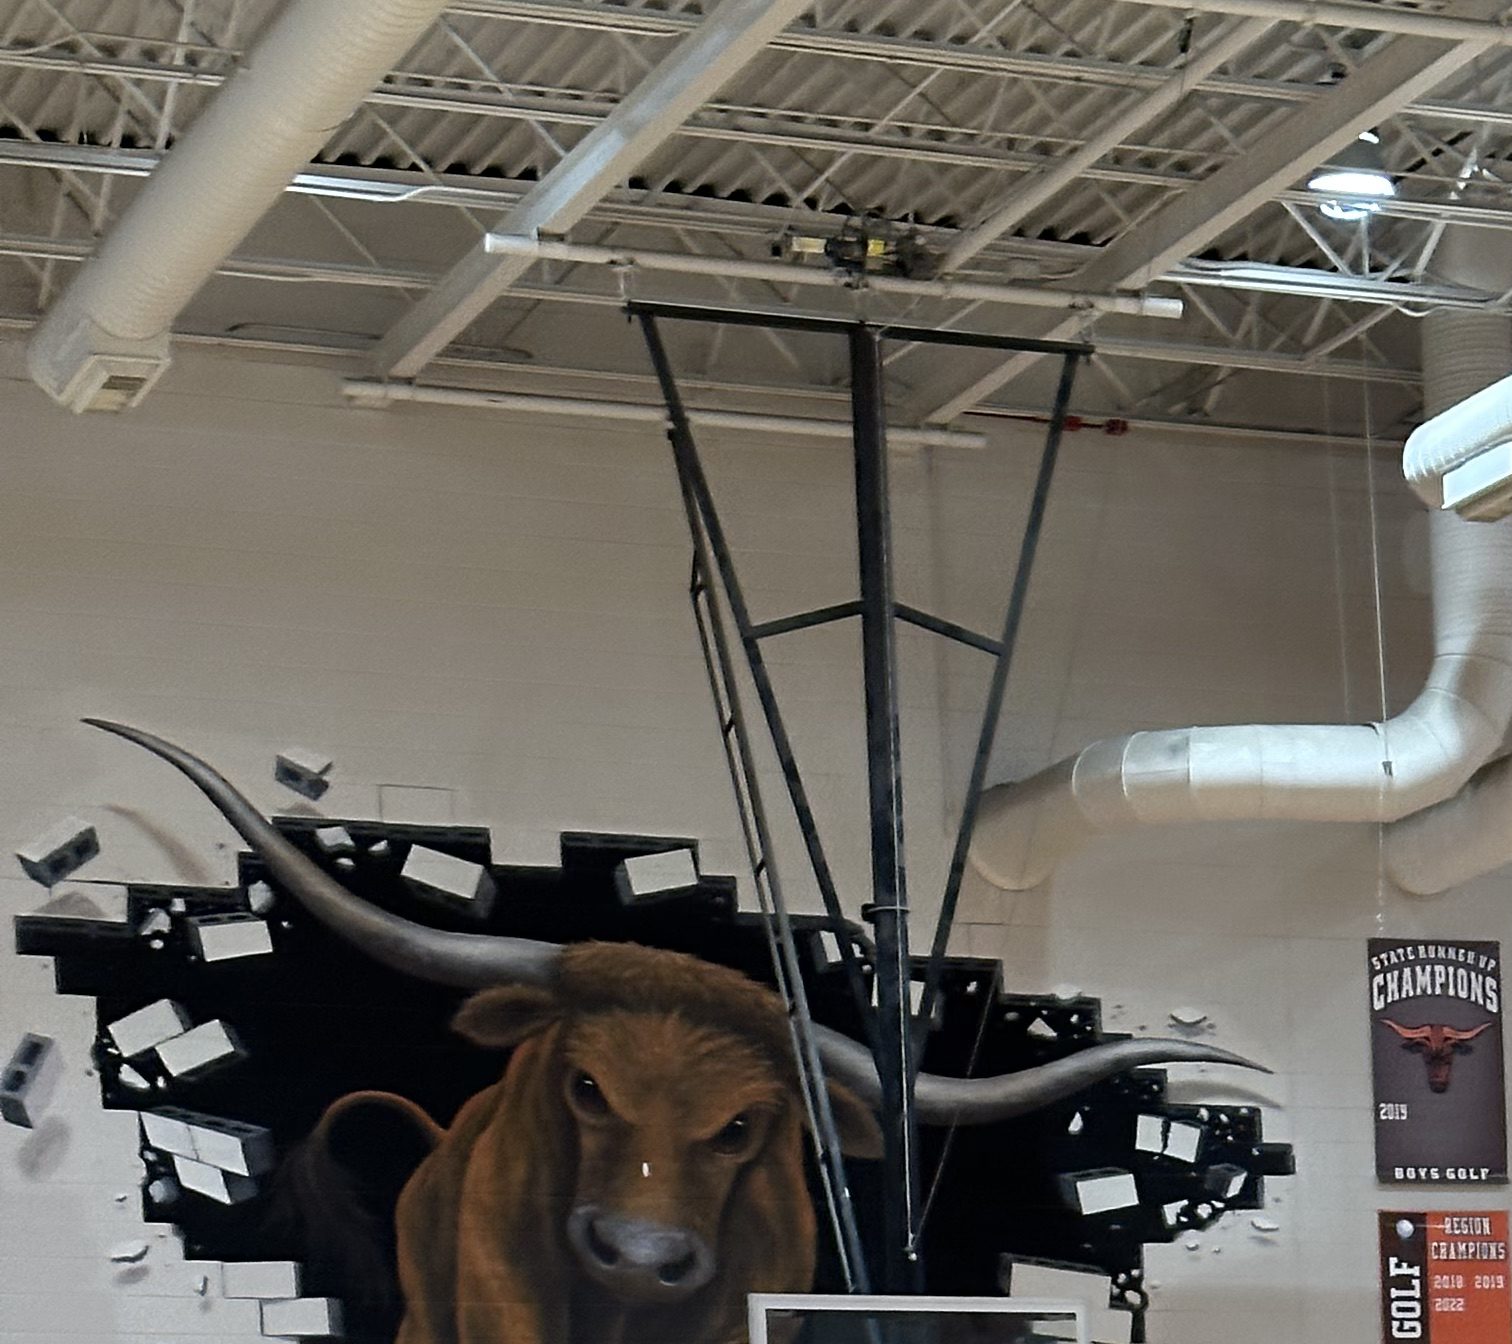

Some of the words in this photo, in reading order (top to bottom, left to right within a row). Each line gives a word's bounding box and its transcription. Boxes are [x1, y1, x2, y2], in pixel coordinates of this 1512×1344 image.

[1372, 947, 1415, 970] STATE
[1418, 945, 1475, 964] RUNNER
[1479, 955, 1496, 971] UP
[1372, 965, 1498, 1013] CHAMPIONS
[1379, 1103, 1408, 1120] 2019
[1395, 1168, 1440, 1179] BOYS
[1446, 1168, 1489, 1180] GOLF
[1444, 1217, 1491, 1235] REGION
[1431, 1242, 1505, 1260] CHAMPIONS
[1389, 1257, 1421, 1338] GOLF
